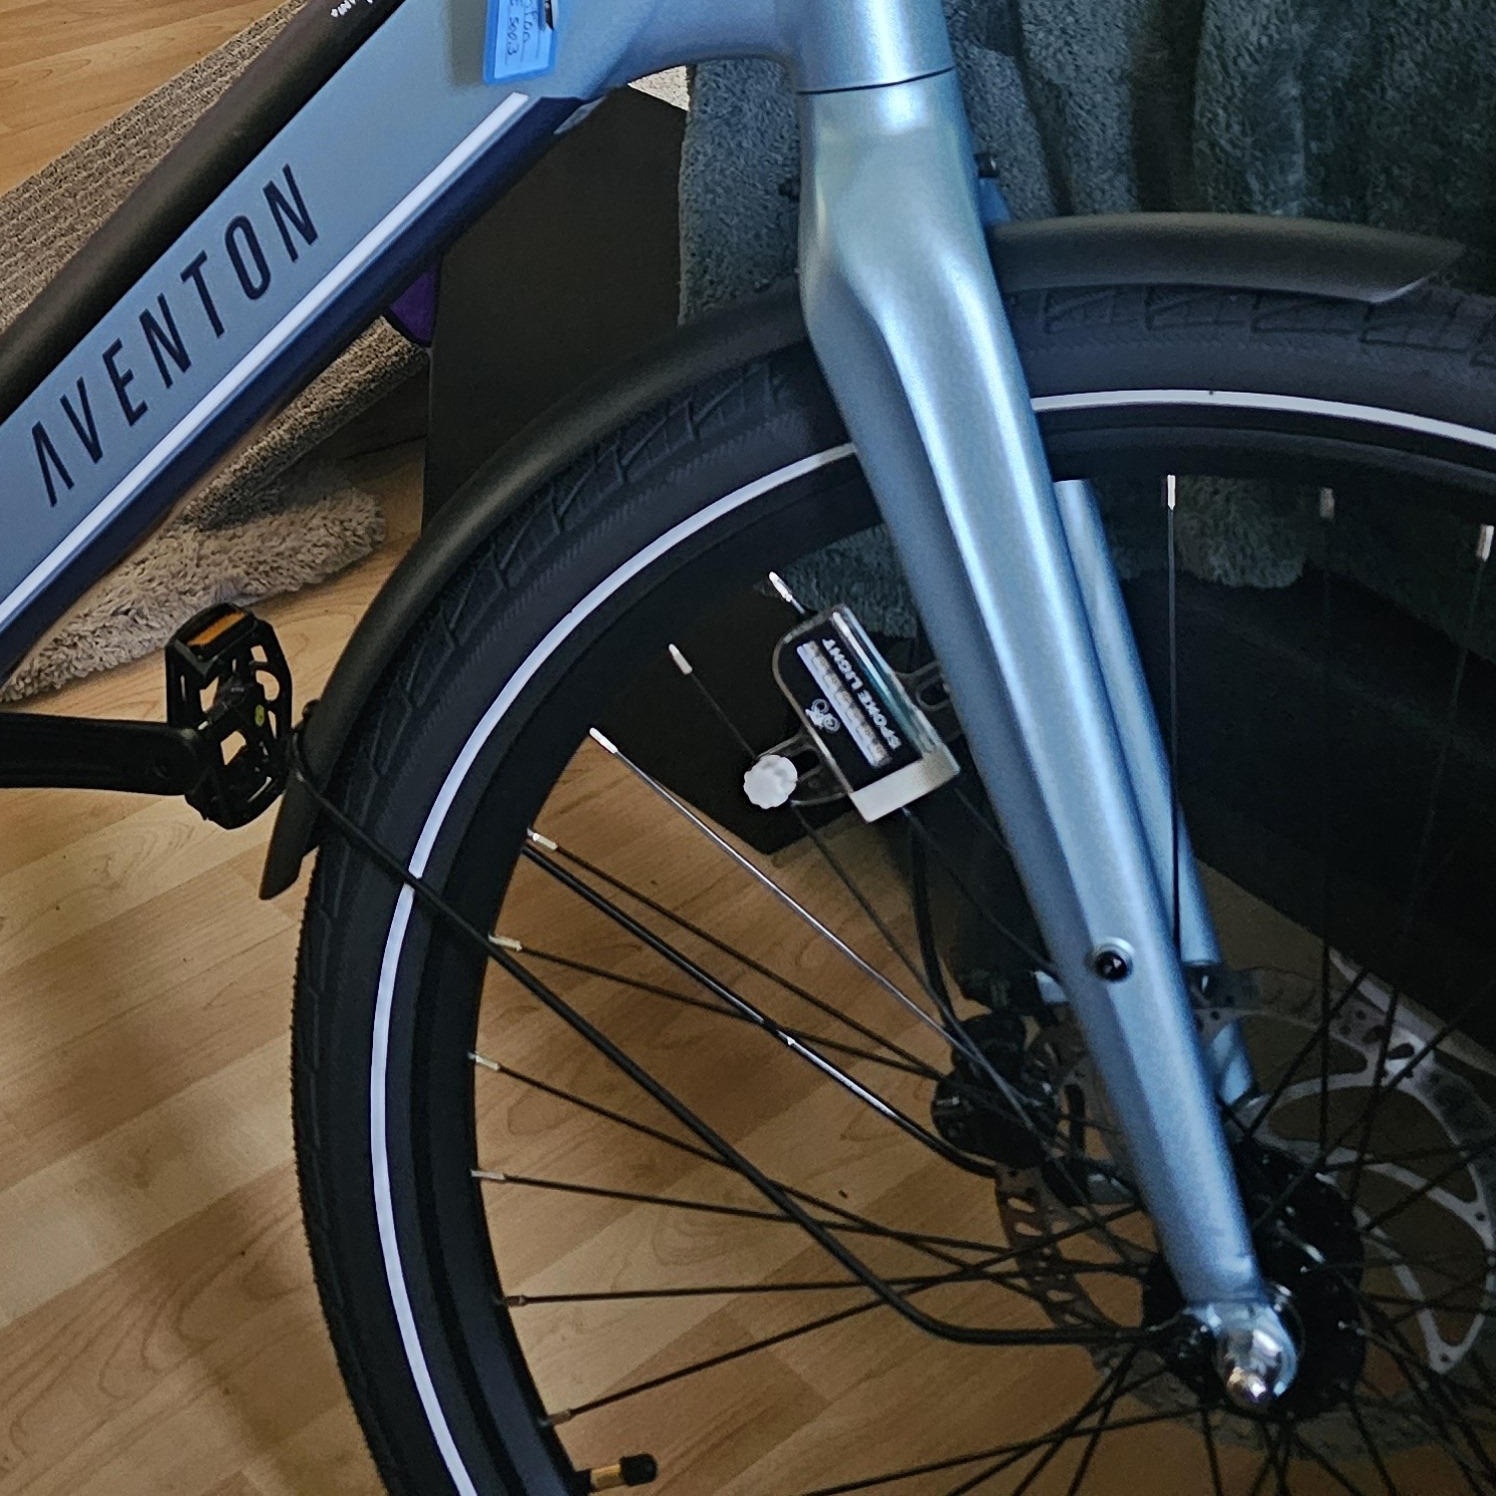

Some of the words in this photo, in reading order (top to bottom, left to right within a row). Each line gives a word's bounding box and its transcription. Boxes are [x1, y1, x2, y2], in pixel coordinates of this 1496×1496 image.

[31, 163, 319, 508] AVENTON
[821, 637, 864, 690] LIGHT
[857, 690, 901, 750] SPOKE
